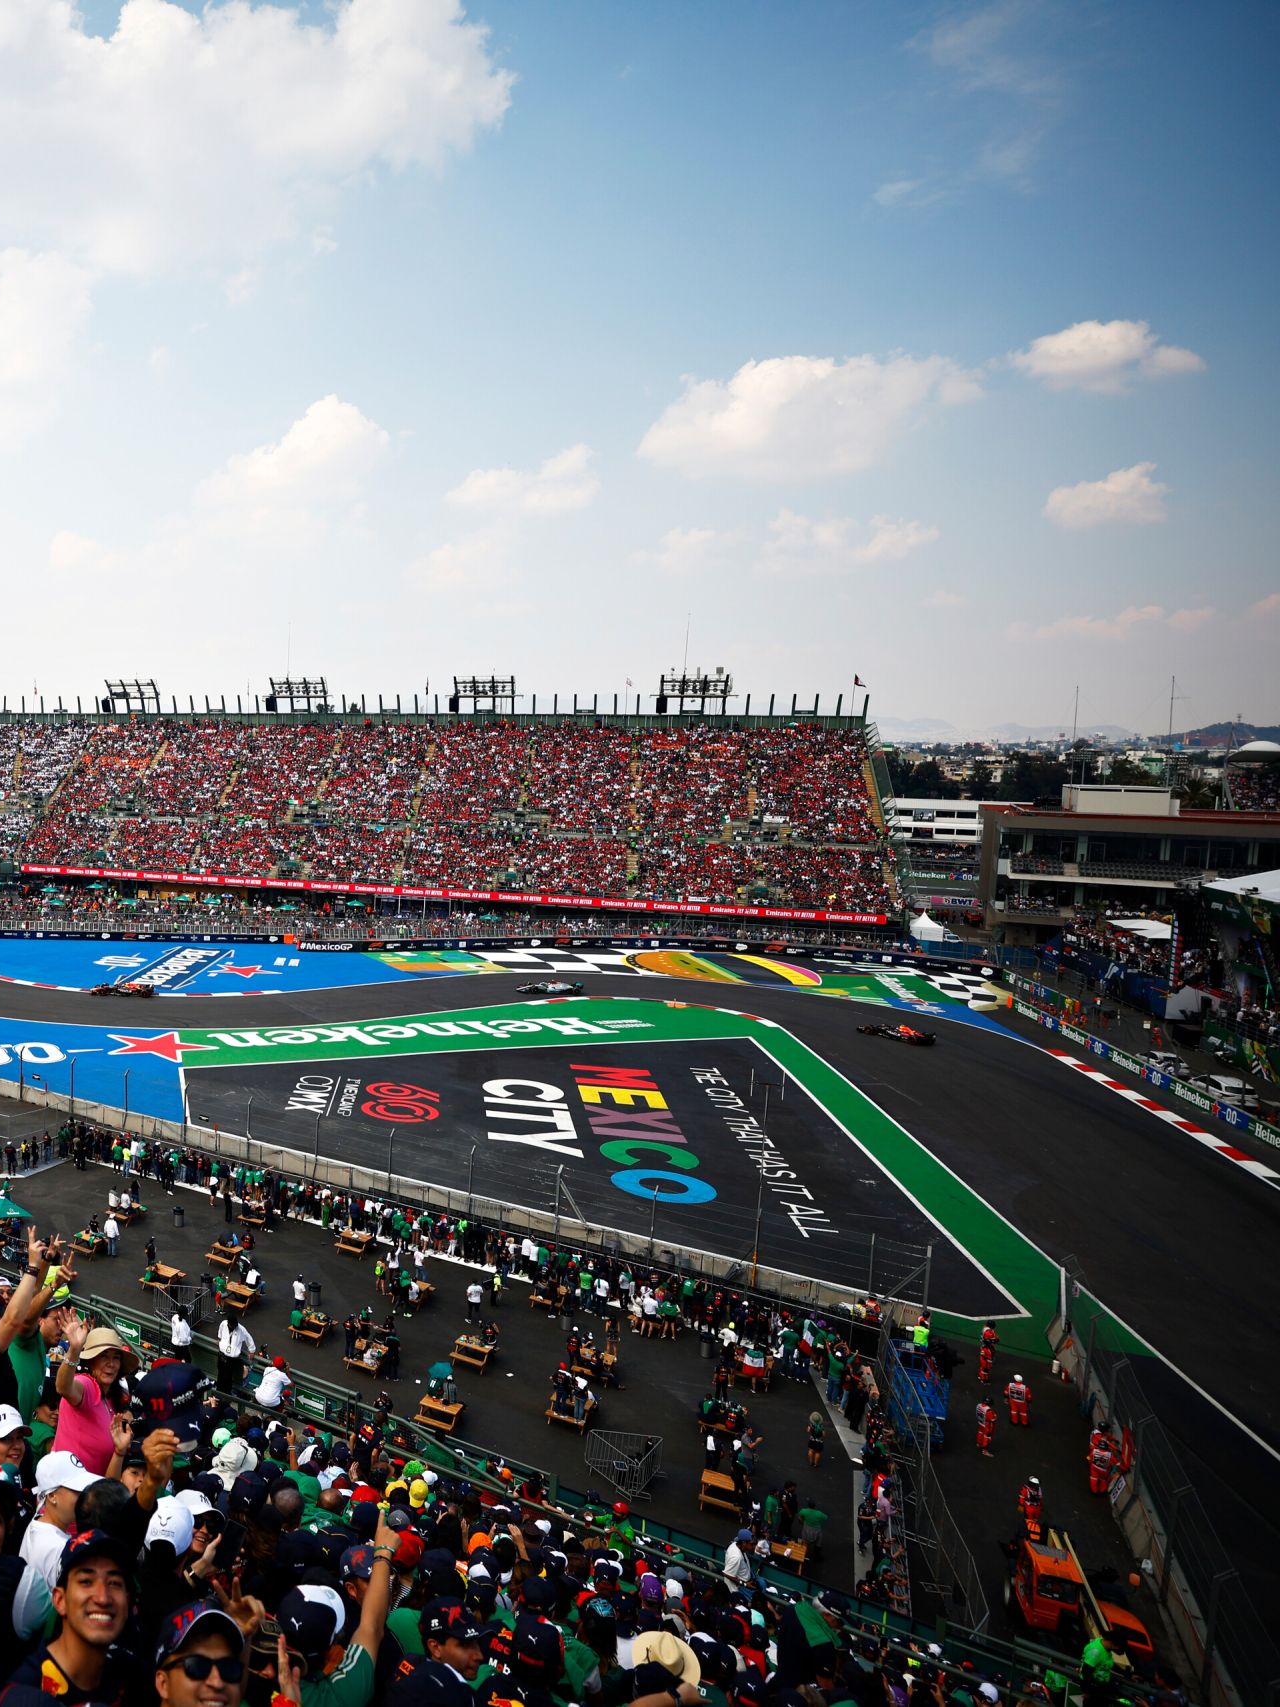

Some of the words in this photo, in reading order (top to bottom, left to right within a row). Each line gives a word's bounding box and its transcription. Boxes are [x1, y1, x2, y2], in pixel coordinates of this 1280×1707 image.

[300, 942, 353, 951] #MexicoGP
[1018, 1002, 1038, 1021] Heineken
[207, 1016, 620, 1048] Heineken
[1061, 1024, 1085, 1046] Heineken
[1112, 1048, 1140, 1075] Heineken
[690, 1067, 729, 1086] THE
[284, 1075, 334, 1114] CDMX
[705, 1088, 750, 1114] CITY
[1175, 1083, 1210, 1111] Heineken
[482, 1078, 585, 1159] CITY
[569, 1063, 718, 1205] MEXICO
[723, 1116, 775, 1149] THAT
[743, 1148, 797, 1181] HAS
[767, 1181, 815, 1201] IT
[779, 1200, 840, 1238] ALL
[150, 1396, 166, 1412] 11
[171, 1609, 195, 1630] 11
